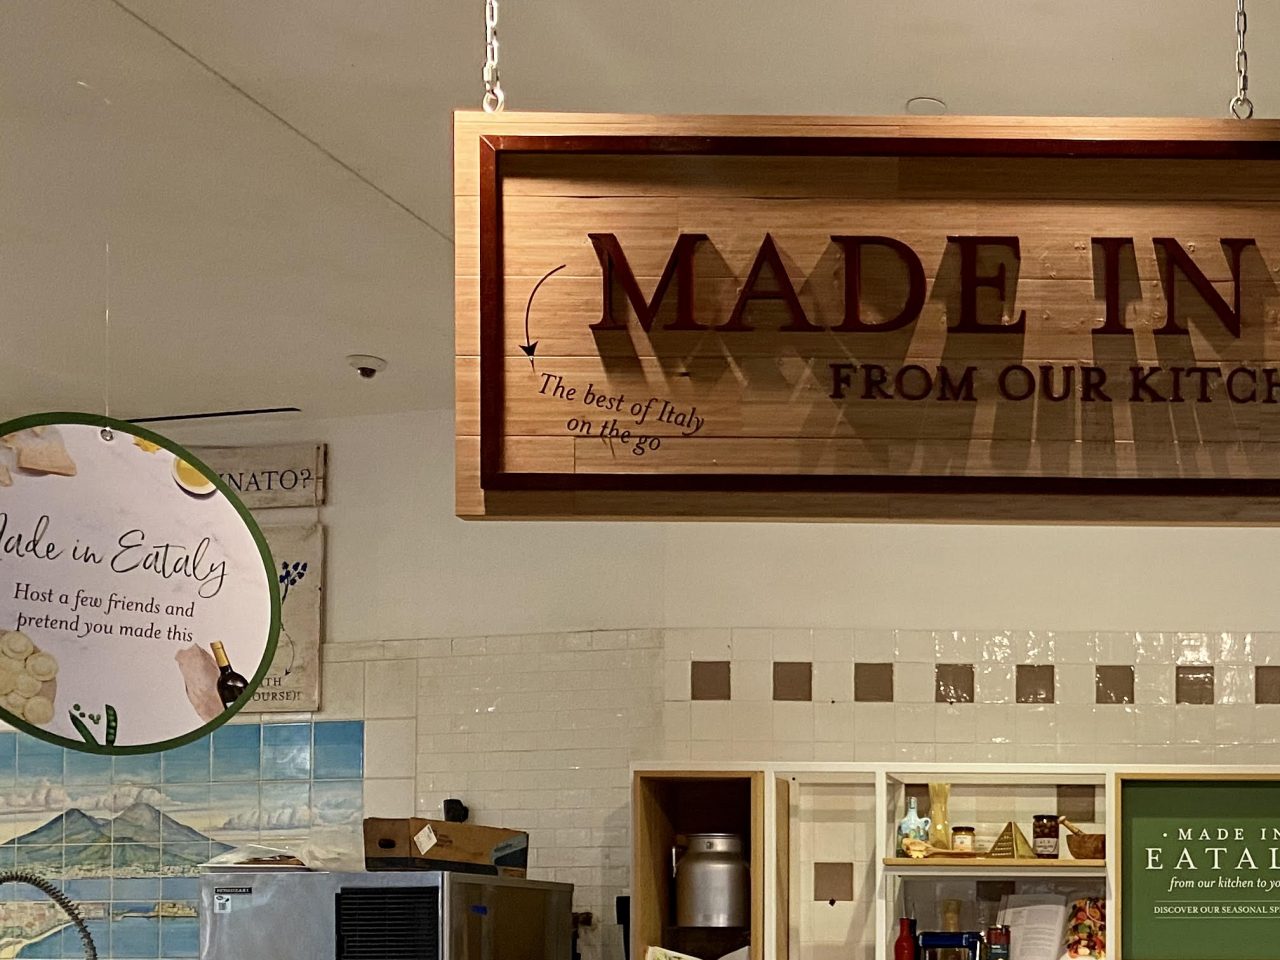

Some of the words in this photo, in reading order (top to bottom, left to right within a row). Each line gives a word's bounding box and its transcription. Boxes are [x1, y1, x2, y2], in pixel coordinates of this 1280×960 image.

[587, 231, 1027, 335] MADE
[1091, 236, 1256, 338] IN
[828, 363, 979, 401] FROM
[998, 364, 1113, 402] OUR
[538, 373, 577, 401] The
[583, 383, 625, 412] best
[630, 397, 658, 425] of
[656, 400, 705, 436] Italy
[566, 418, 592, 435] on
[600, 418, 631, 445] the
[632, 435, 661, 456] go
[219, 469, 311, 491] NATO?
[72, 539, 104, 564] in
[110, 529, 228, 599] Eataly
[14, 582, 54, 604] Host
[58, 593, 69, 605] a
[70, 589, 103, 611] few
[104, 593, 161, 615] friends
[165, 601, 195, 618] and
[16, 611, 80, 632] pretend
[77, 621, 114, 638] you
[119, 622, 162, 640] made
[166, 624, 194, 642] this
[1178, 828, 1245, 841] MADE
[1168, 876, 1195, 892] from
[1197, 879, 1216, 889] our
[1218, 876, 1254, 889] kitchen
[1256, 878, 1267, 889] to
[1154, 906, 1199, 914] DISCOVER
[1200, 906, 1220, 914] OUR
[1222, 906, 1268, 914] SEASONAL
